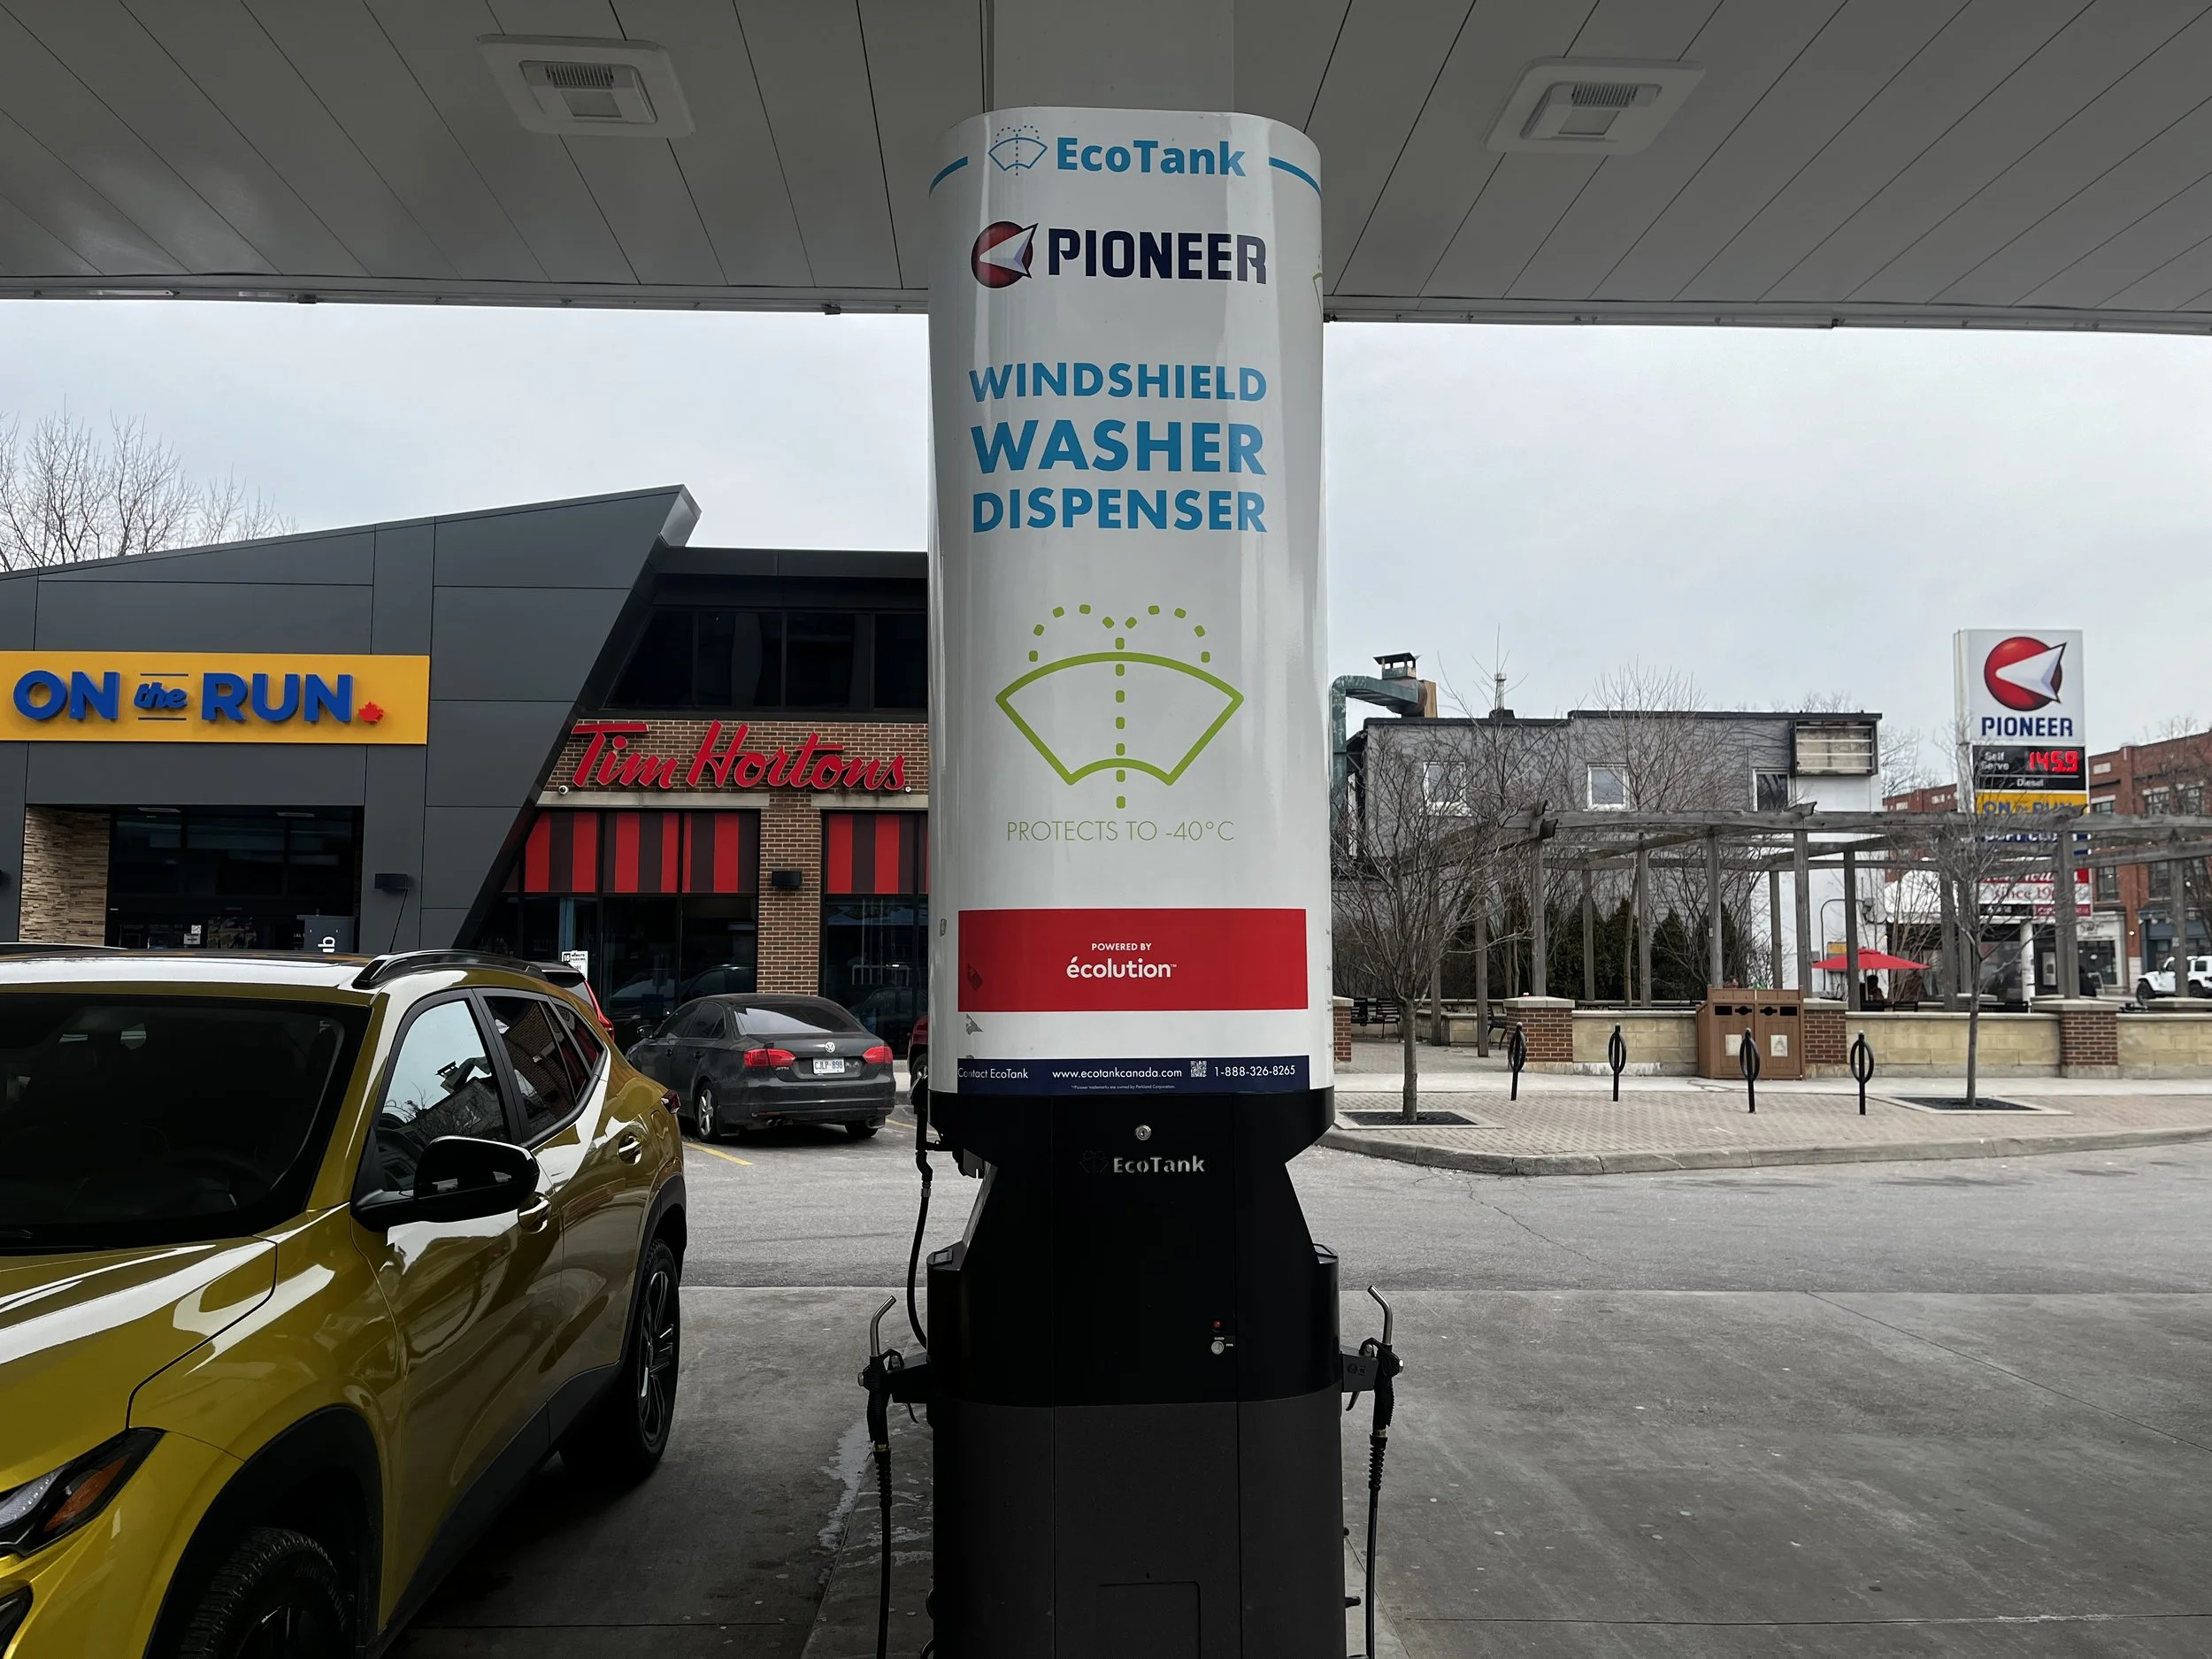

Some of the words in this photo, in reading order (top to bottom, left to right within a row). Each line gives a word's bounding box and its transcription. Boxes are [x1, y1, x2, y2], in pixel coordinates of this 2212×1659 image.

[1056, 136, 1247, 177] EcoTank
[1048, 227, 1267, 285] PIONEER
[969, 362, 1268, 403] WINDSHIELD
[970, 419, 1268, 476] WASHER
[972, 487, 1268, 534] DISPENSER
[12, 670, 120, 721] ON
[134, 681, 188, 710] the
[201, 672, 354, 724] RUN
[1981, 717, 2073, 737] PIONEER
[571, 723, 679, 788] Tim
[685, 719, 906, 791] Hortons
[1984, 751, 2005, 762] Self
[2016, 779, 2044, 787] Diesel
[1007, 820, 1118, 841] PROTECTS
[1125, 820, 1157, 841] TO
[1165, 820, 1235, 841] -40°C
[1091, 942, 1138, 951] POWERED
[1140, 942, 1152, 951] BY
[957, 1067, 988, 1079] Contact
[990, 1067, 1029, 1079] EcoTank
[1051, 1066, 1183, 1079] www.ecotankcanada.com
[1214, 1064, 1296, 1078] 1-888-326-8265
[1113, 1155, 1205, 1173] EcoTank
